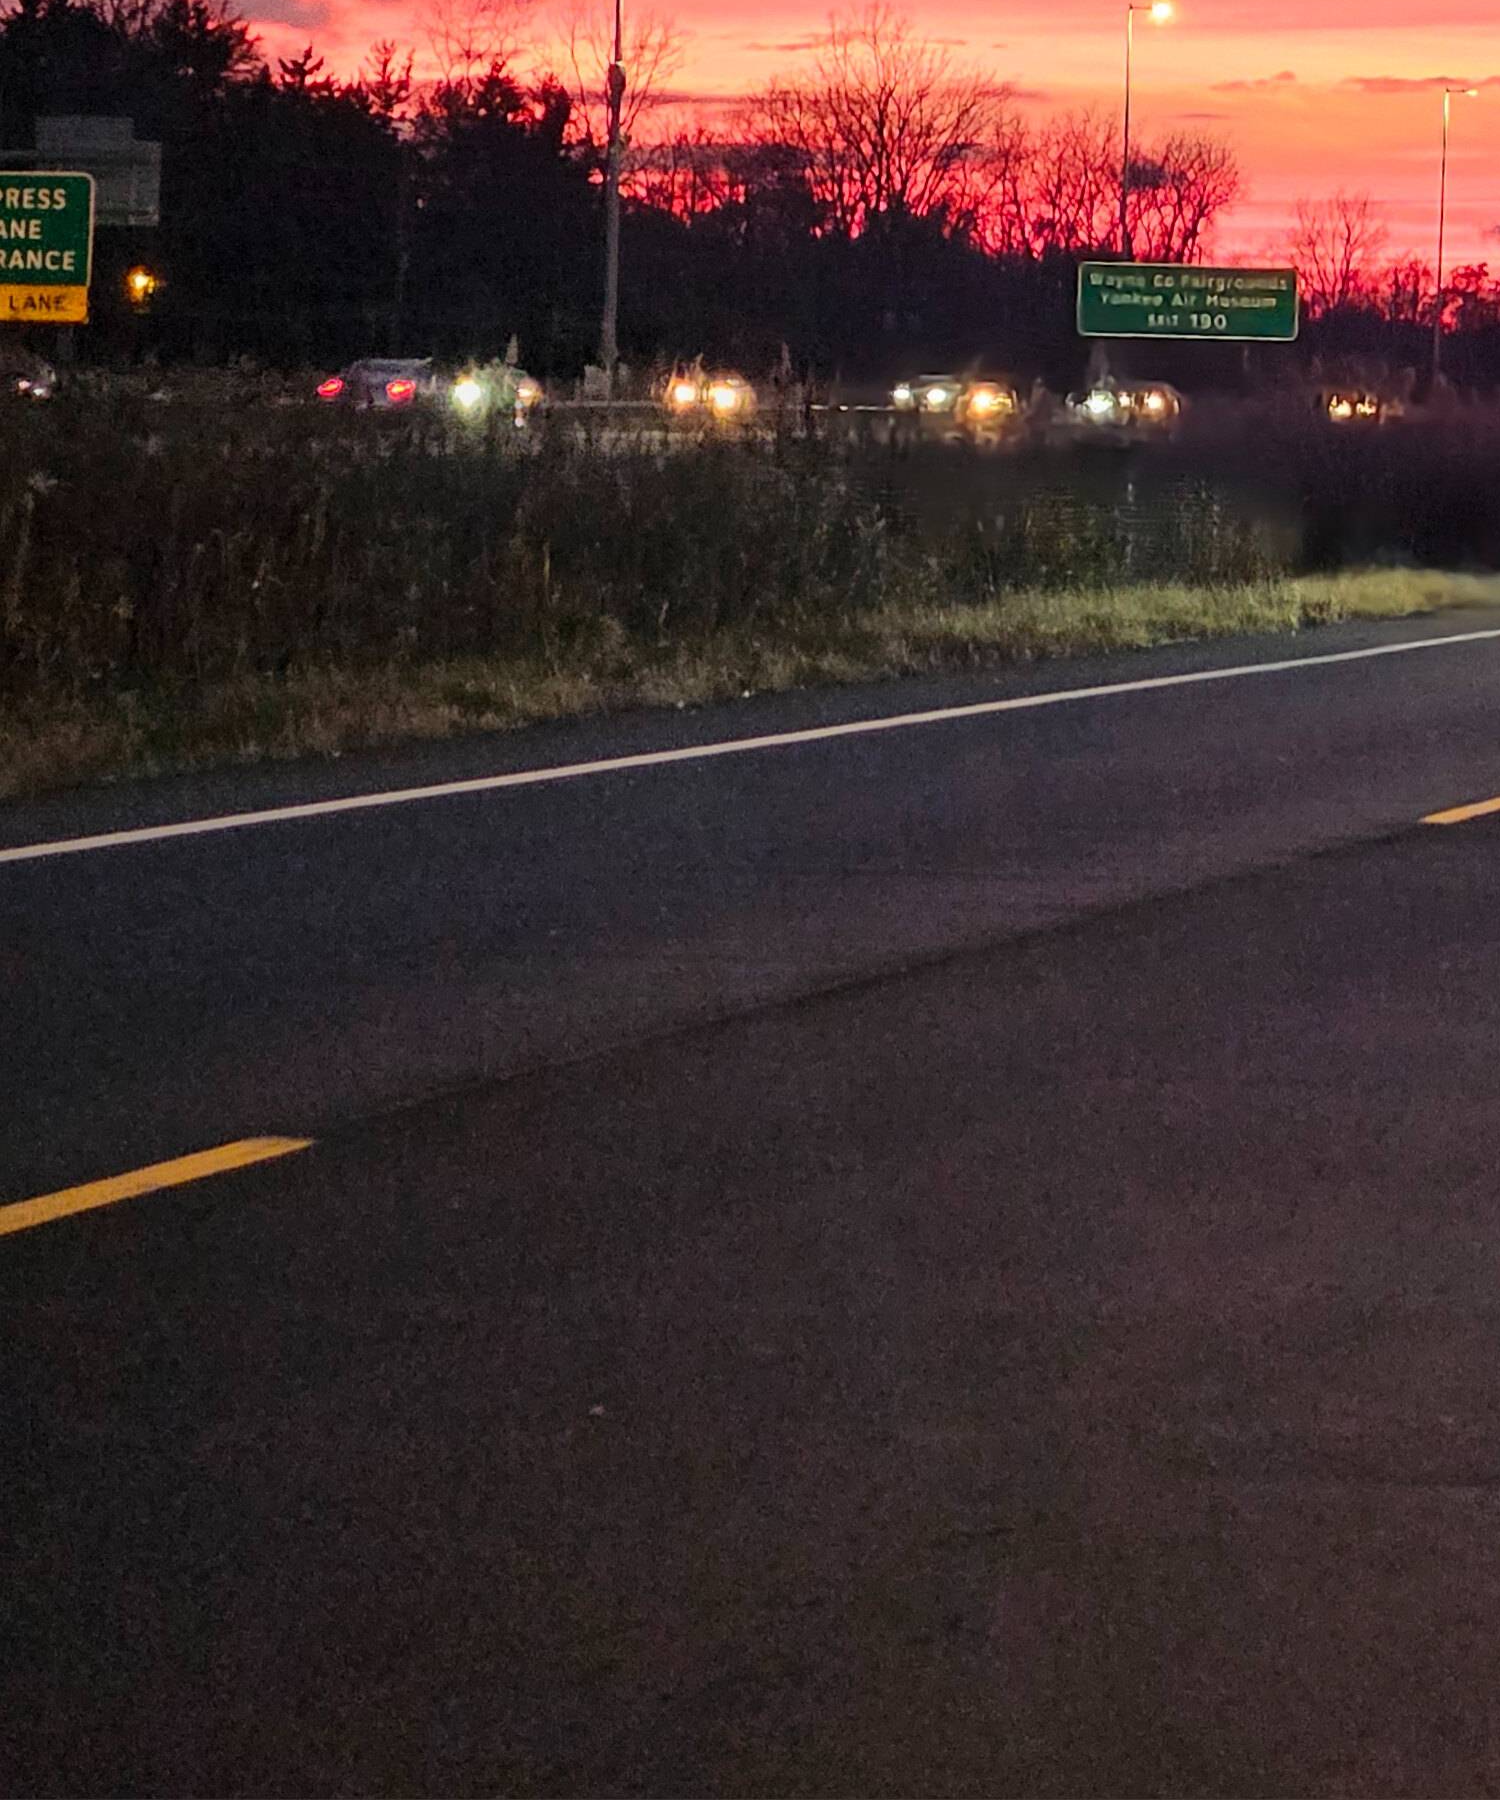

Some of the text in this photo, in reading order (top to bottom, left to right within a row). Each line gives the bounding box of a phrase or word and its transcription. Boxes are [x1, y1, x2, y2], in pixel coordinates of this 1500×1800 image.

[0, 187, 66, 210] RESS
[1153, 274, 1174, 288] Co
[9, 294, 67, 312] LANE
[1171, 292, 1196, 307] Air
[1189, 314, 1227, 330] 190
